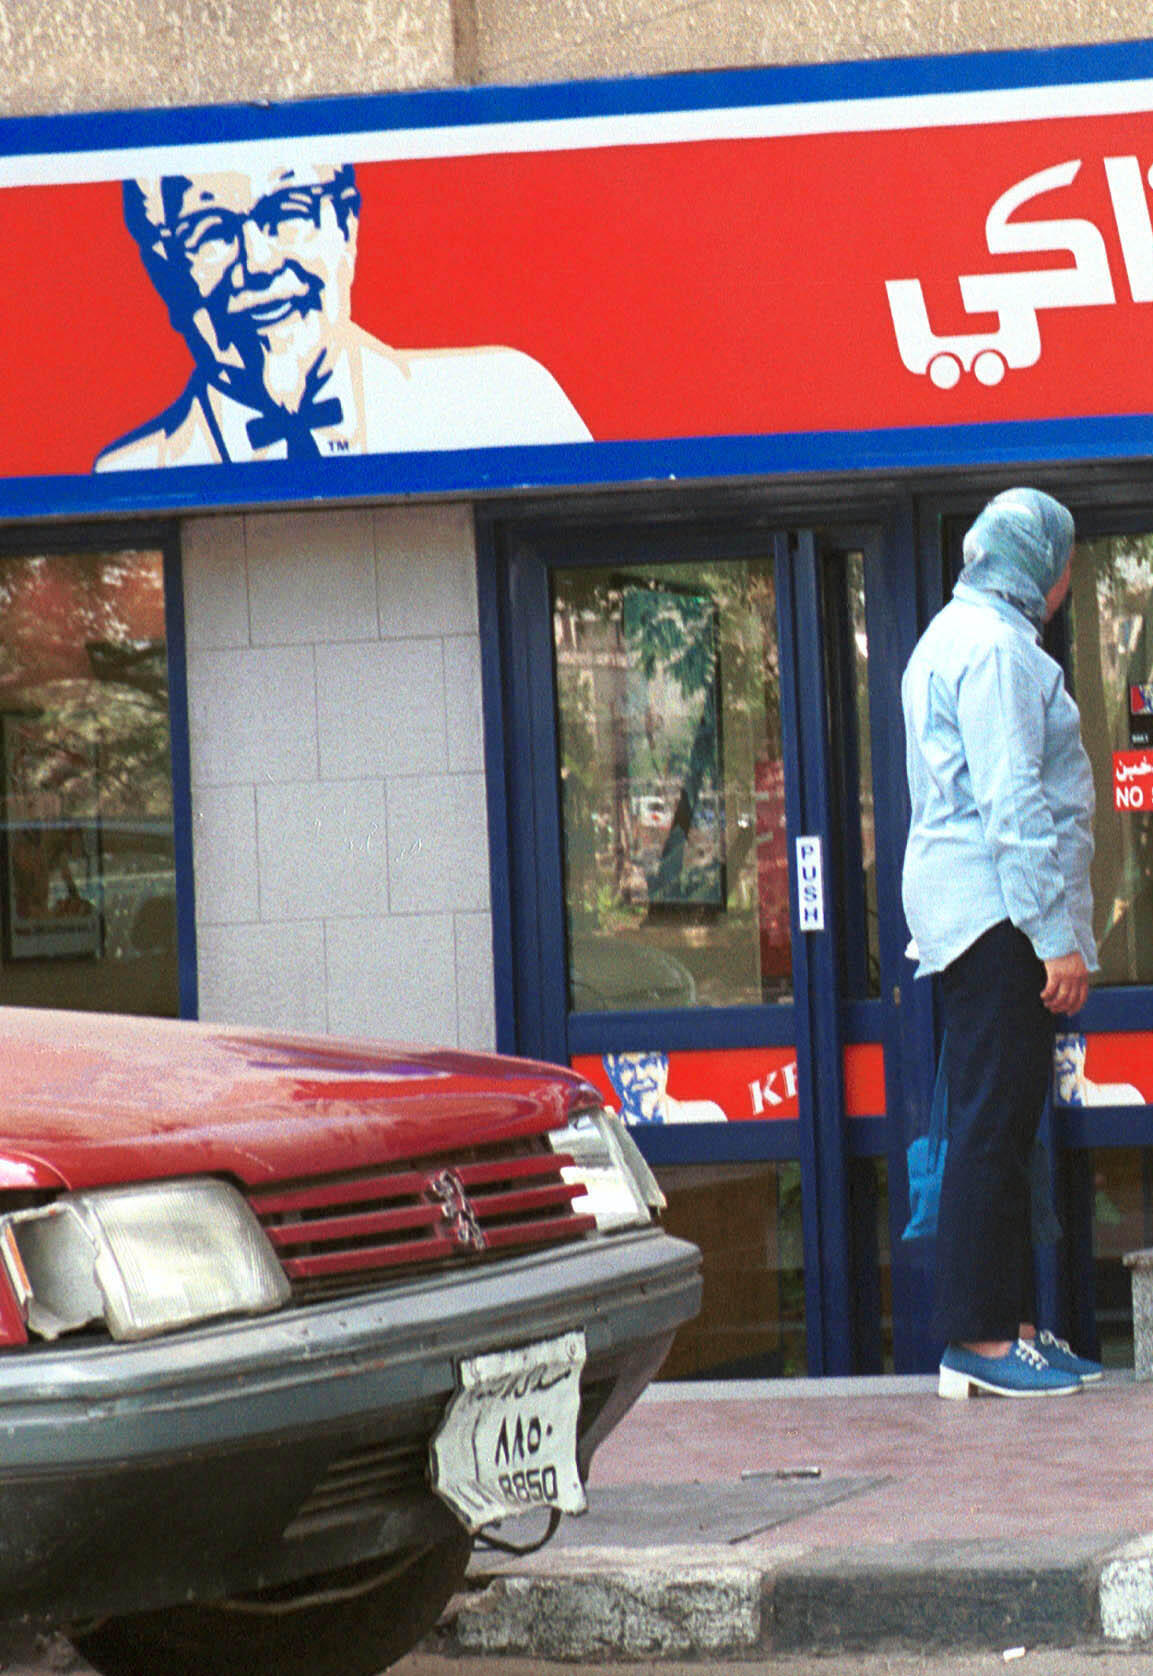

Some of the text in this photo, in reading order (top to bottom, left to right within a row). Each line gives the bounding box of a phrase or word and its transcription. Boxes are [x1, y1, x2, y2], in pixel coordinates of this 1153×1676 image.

[1116, 784, 1144, 808] NO
[801, 844, 819, 923] PUSH
[748, 1061, 798, 1115] KF
[494, 1412, 554, 1467] ٨٨٥٠
